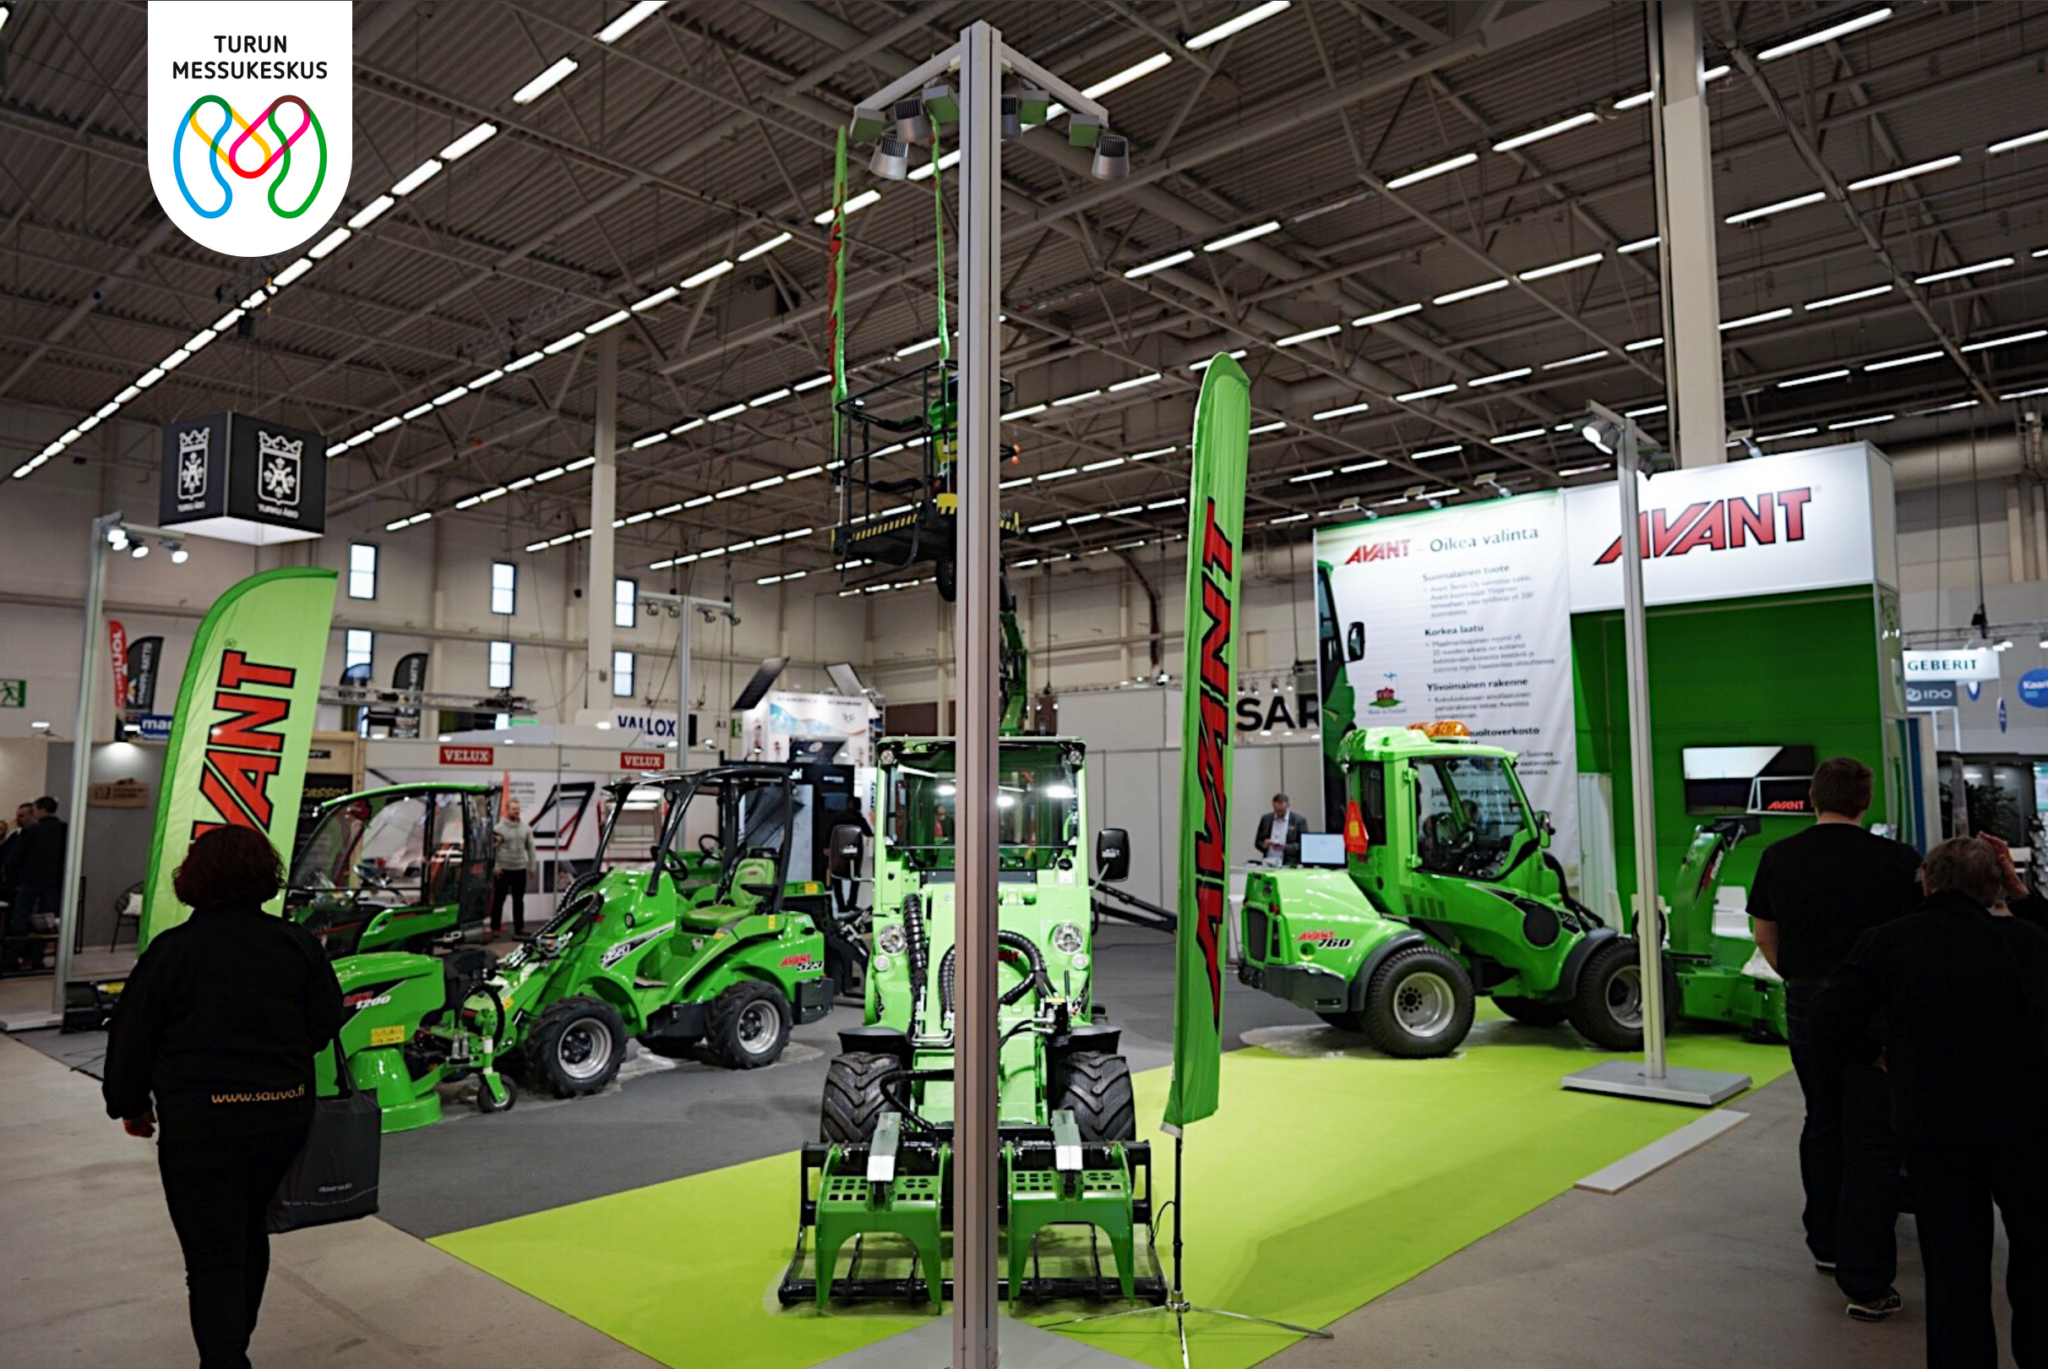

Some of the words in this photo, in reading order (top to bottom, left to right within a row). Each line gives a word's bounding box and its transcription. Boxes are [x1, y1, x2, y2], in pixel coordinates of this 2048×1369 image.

[1593, 487, 1812, 566] AVANT
[1344, 539, 1411, 565] AVANT
[1430, 536, 1477, 553] Oikea
[1482, 528, 1539, 545] valinta
[1422, 567, 1482, 583] Suomalainen
[1484, 564, 1511, 574] tuote
[1424, 627, 1458, 636] Korkea
[1460, 624, 1484, 633] laatu
[1907, 659, 1978, 671] GEBERIT
[1427, 681, 1486, 692] Ylivoimainen
[1488, 678, 1529, 688] rakenne
[1923, 689, 1953, 700] IDO
[618, 715, 677, 737] VALLOX
[190, 649, 296, 837] VANT
[444, 749, 490, 762] VELUX
[624, 756, 661, 766] VELUX
[1766, 800, 1805, 811] AVANT
[1317, 938, 1353, 949] 760
[796, 960, 824, 972] 523
[355, 994, 392, 1010] 1200
[211, 1084, 306, 1104] www.sauvo.fi
